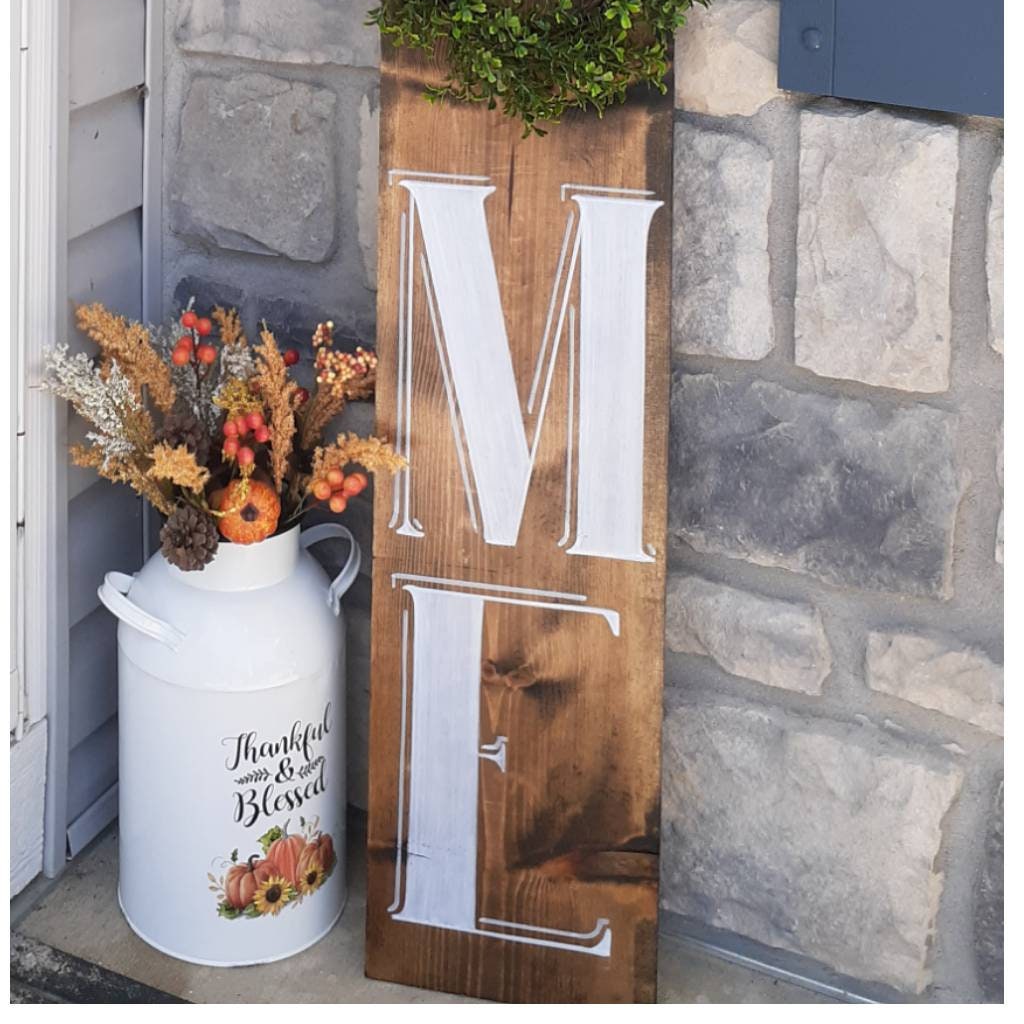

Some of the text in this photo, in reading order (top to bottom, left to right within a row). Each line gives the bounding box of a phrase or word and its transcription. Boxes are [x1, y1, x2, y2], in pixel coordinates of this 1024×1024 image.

[221, 701, 332, 772] Thankful
[274, 756, 296, 785] &
[232, 756, 329, 828] Blessed
